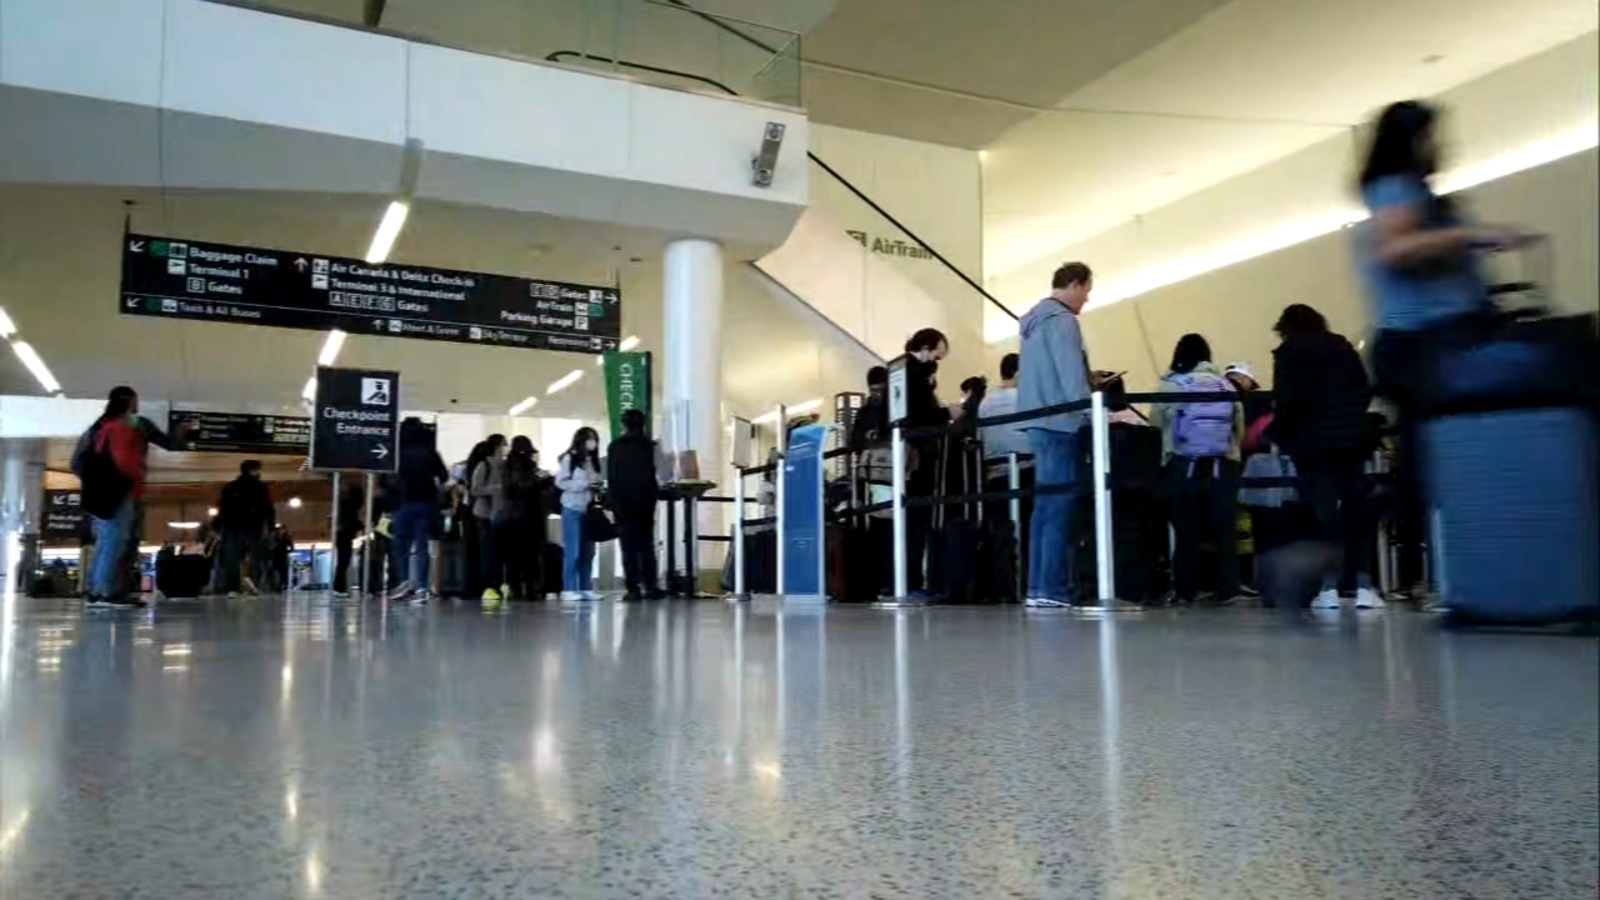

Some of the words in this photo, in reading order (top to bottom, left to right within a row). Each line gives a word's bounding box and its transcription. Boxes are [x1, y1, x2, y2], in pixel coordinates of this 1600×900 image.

[189, 246, 242, 263] Baggage
[245, 252, 278, 266] Claim
[872, 237, 934, 260] AirTrain
[190, 263, 240, 278] Terminal
[243, 269, 250, 279] 1
[331, 262, 346, 273] Air
[349, 264, 389, 278] Canada
[401, 271, 429, 282] Delta
[207, 281, 243, 294] Gates
[331, 278, 377, 292] Terminal
[399, 286, 466, 300] International
[560, 287, 588, 300] Gates
[398, 300, 429, 312] Gates
[536, 300, 574, 312] AirTrain
[500, 310, 538, 325] Parking
[540, 314, 573, 327] Garage
[323, 406, 390, 421] Checkpoint
[336, 422, 390, 436] Entrance
